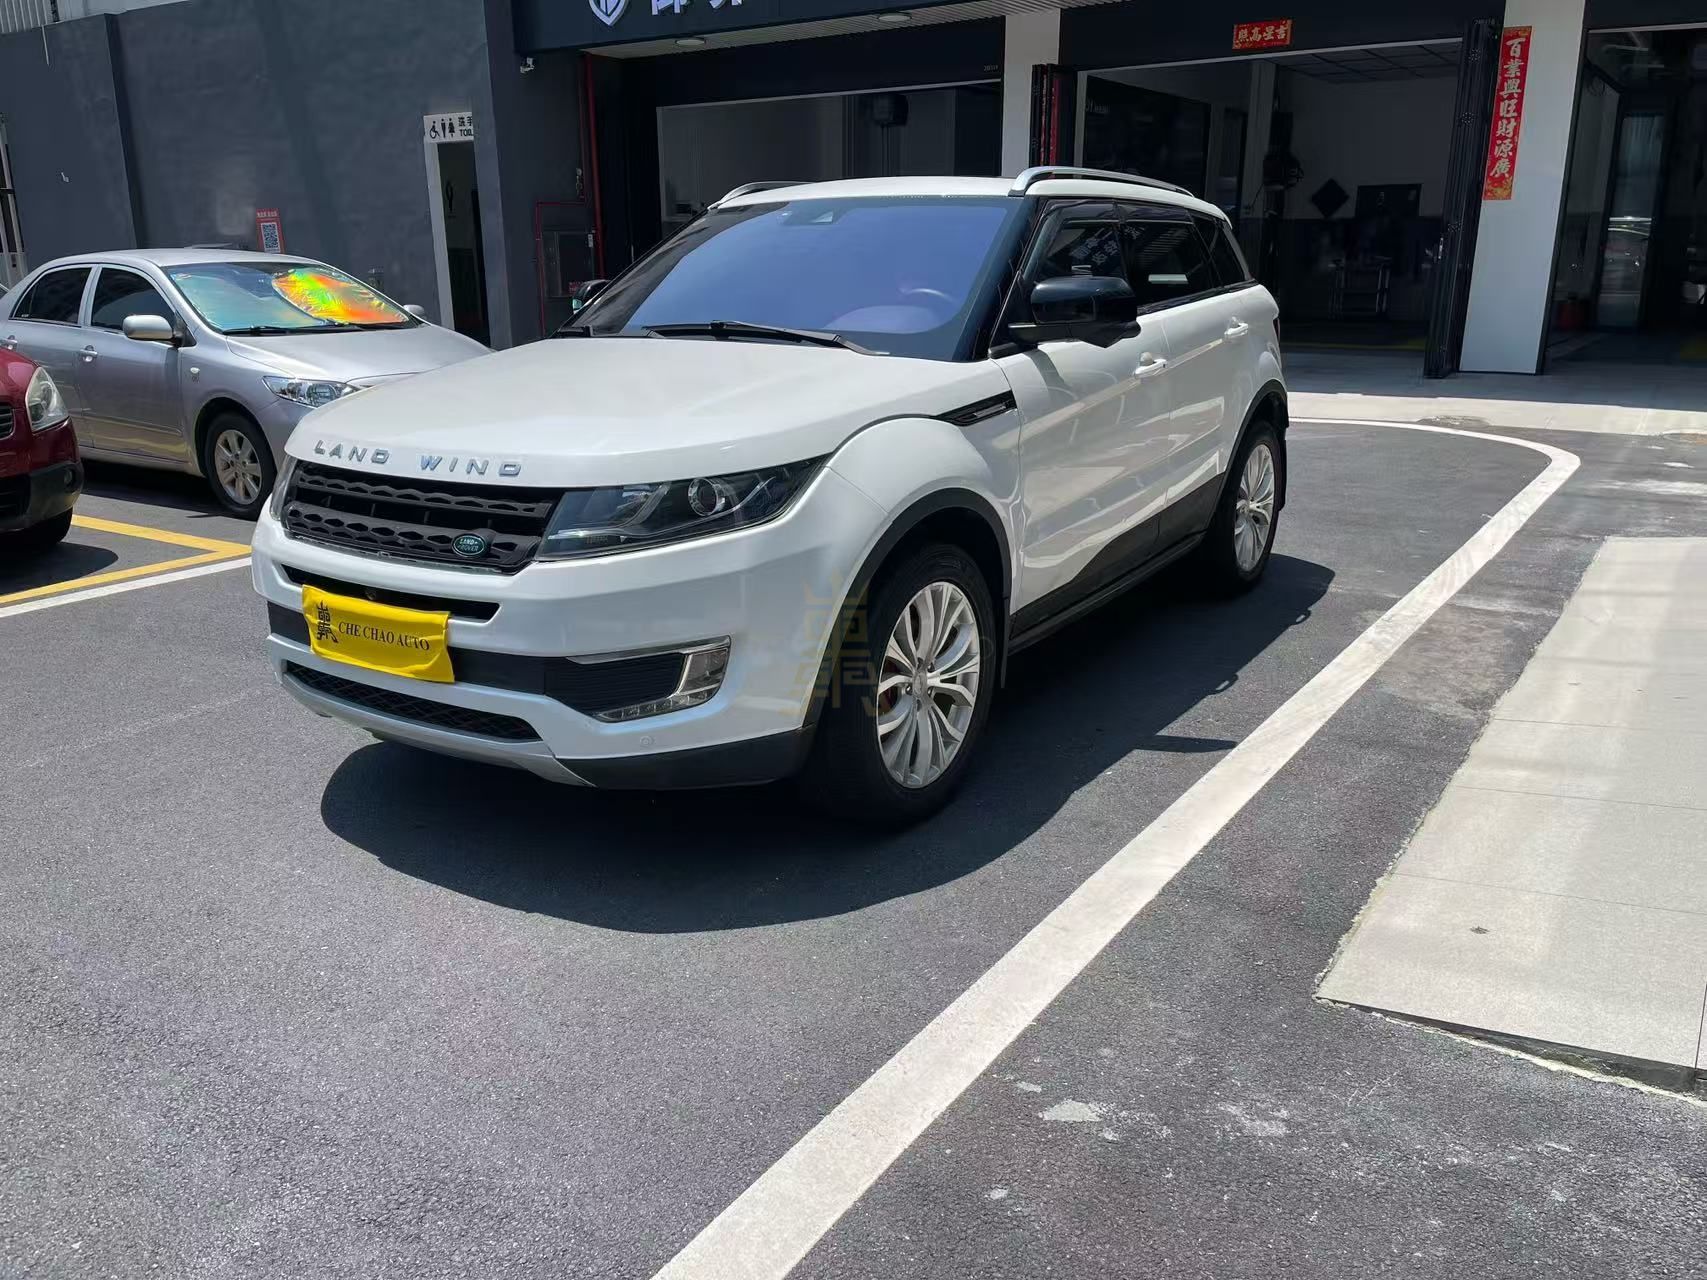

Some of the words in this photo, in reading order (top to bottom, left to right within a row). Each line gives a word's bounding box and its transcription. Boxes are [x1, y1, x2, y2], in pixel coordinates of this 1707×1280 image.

[314, 439, 390, 465] LAND
[419, 455, 522, 477] WIND
[338, 621, 361, 637] CHE
[363, 626, 395, 644] CHAO
[397, 635, 430, 651] AUTO
